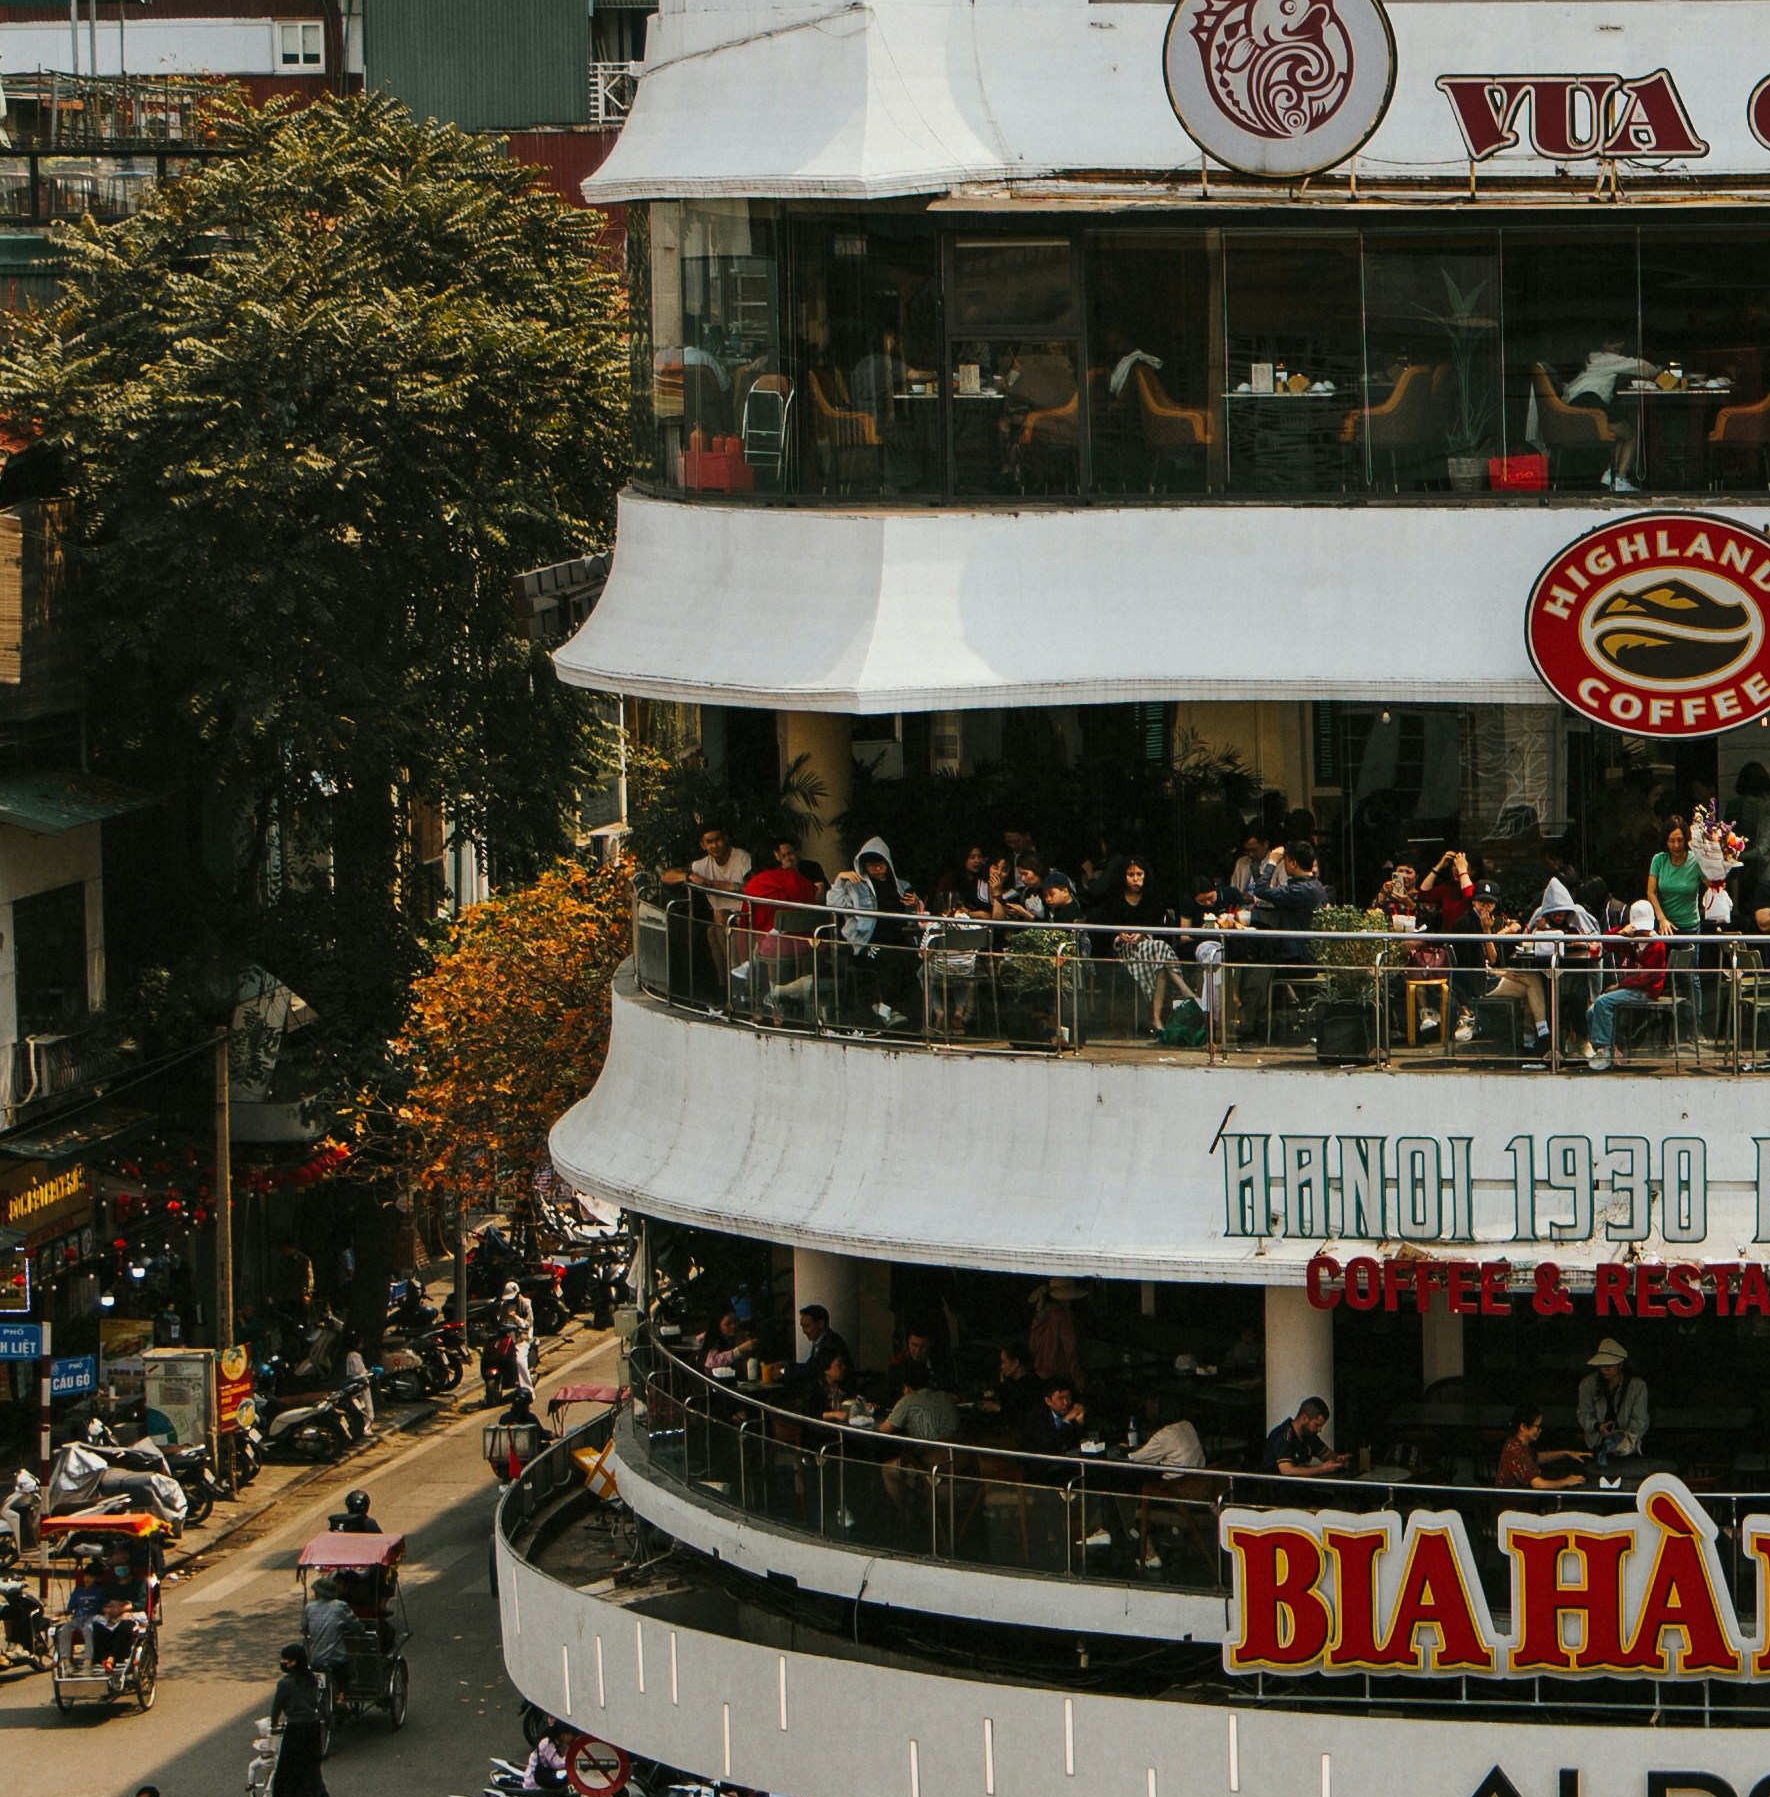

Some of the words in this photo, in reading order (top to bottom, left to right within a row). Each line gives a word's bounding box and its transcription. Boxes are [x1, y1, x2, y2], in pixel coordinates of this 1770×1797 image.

[1436, 68, 1710, 161] VUA
[1223, 1135, 1474, 1242] HANOI
[1506, 1135, 1709, 1243] 1930
[1306, 1255, 1512, 1315] COFFEE
[1532, 1260, 1574, 1316] &
[1225, 1523, 1497, 1674] BIA
[1505, 1490, 1744, 1675] HÀ
